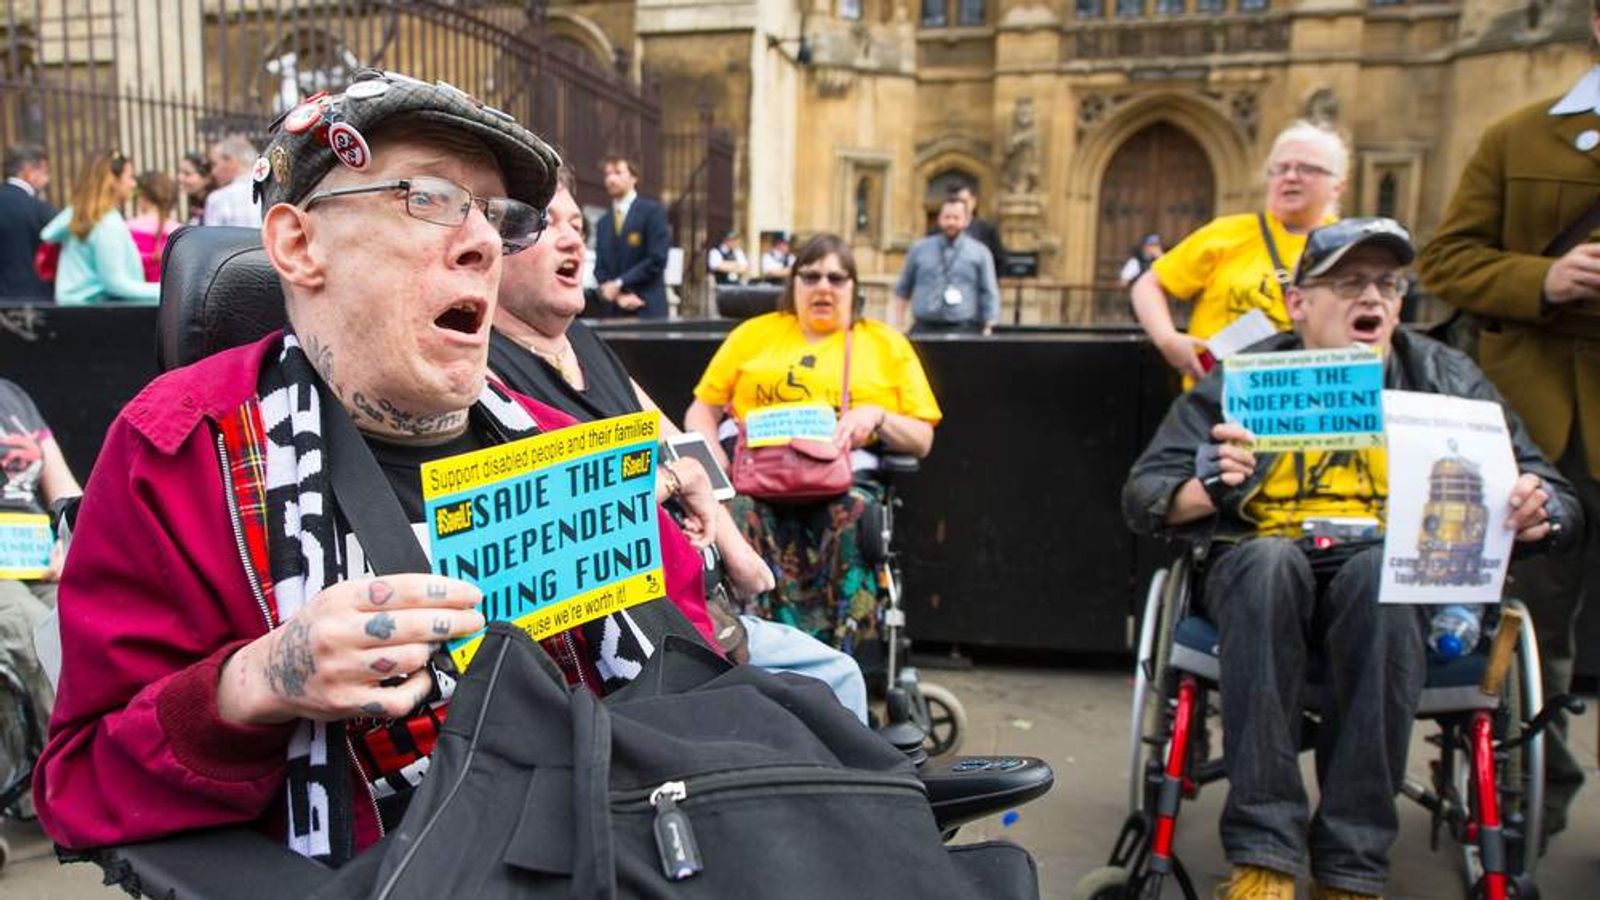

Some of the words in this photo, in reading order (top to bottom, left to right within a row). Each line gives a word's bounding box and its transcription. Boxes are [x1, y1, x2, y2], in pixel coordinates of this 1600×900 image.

[1228, 389, 1379, 412] INDEPENDENT
[1250, 368, 1301, 388] SAVE
[1314, 366, 1351, 385] THE
[1318, 414, 1377, 432] FUND
[429, 464, 480, 493] Support
[483, 449, 529, 478] disabled
[531, 439, 565, 469] people
[568, 430, 586, 454] and
[589, 424, 612, 448] their
[614, 417, 654, 442] families
[473, 474, 550, 528] SAVE
[565, 455, 617, 497] THE
[438, 490, 652, 580] INDEPENDENT
[575, 537, 652, 590] FUND
[554, 602, 583, 627] we're
[585, 590, 615, 615] worth
[616, 584, 627, 605] it!
